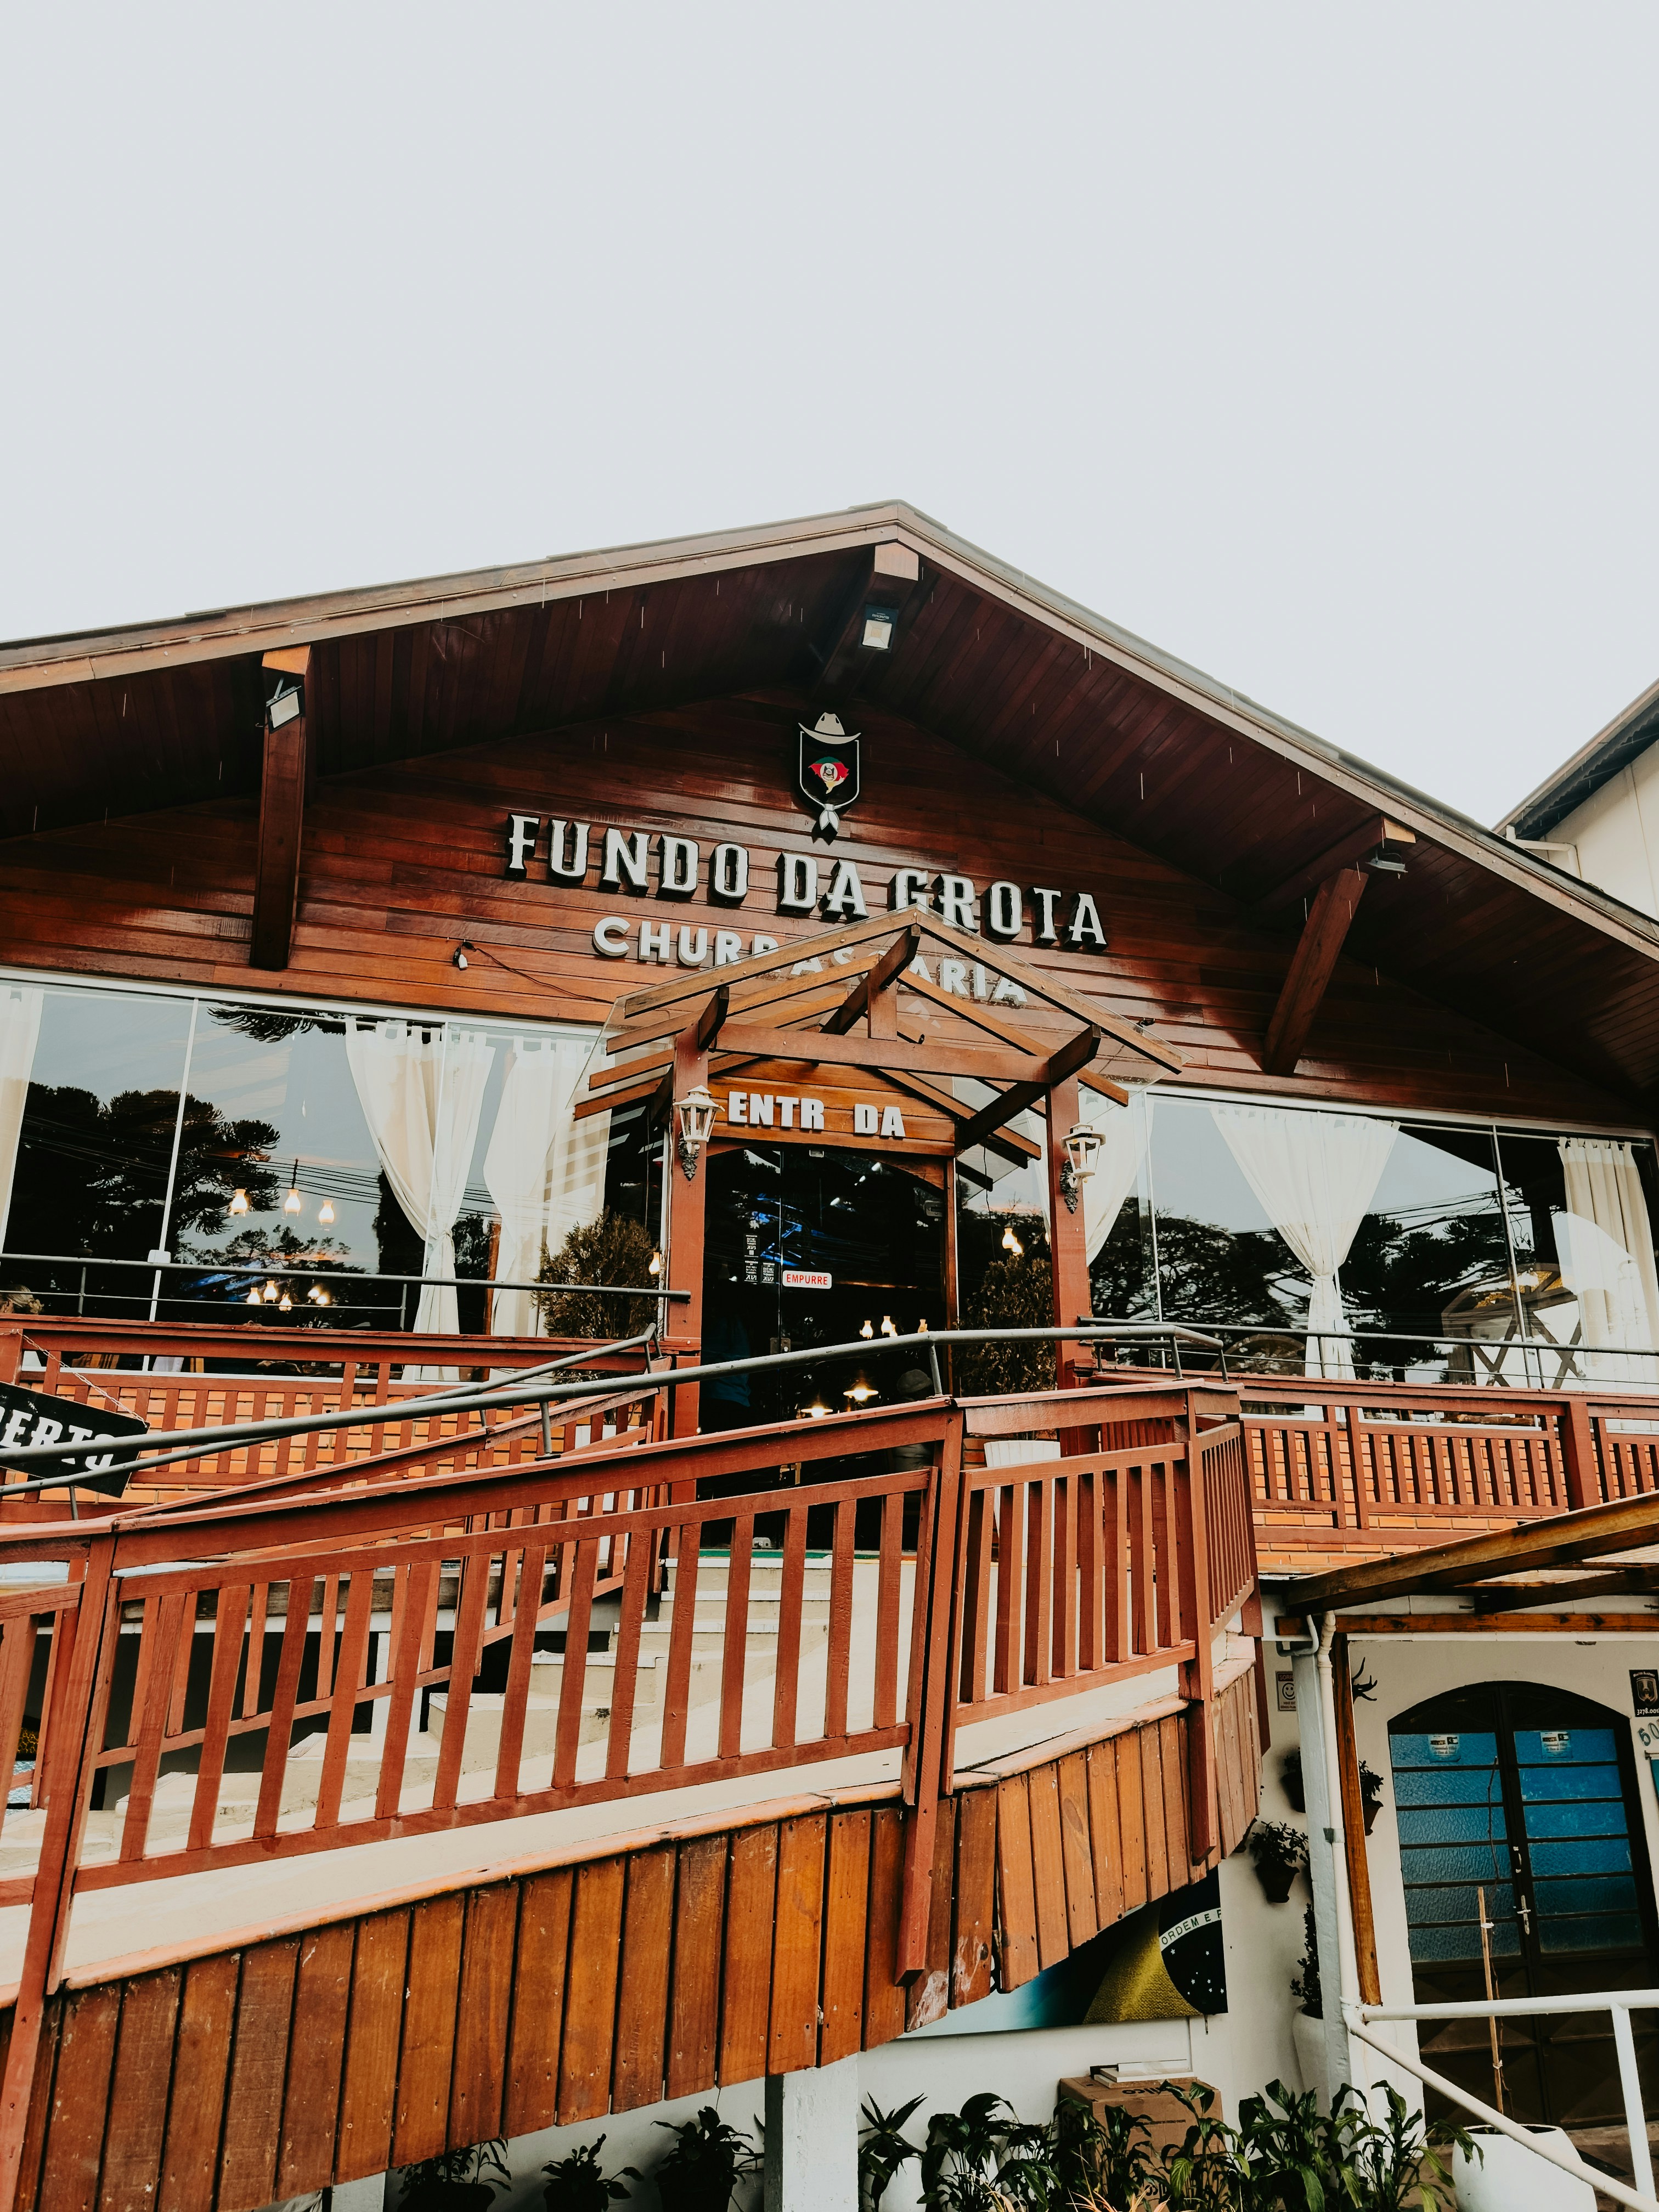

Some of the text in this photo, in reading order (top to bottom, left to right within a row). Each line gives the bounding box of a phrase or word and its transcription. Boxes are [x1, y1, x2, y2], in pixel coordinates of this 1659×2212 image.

[506, 814, 1108, 946] FUNDO DA GROTA
[786, 1274, 828, 1285] EMPURRE
[1161, 1917, 1199, 1945] ORDEM
[1204, 1913, 1211, 1922] E
